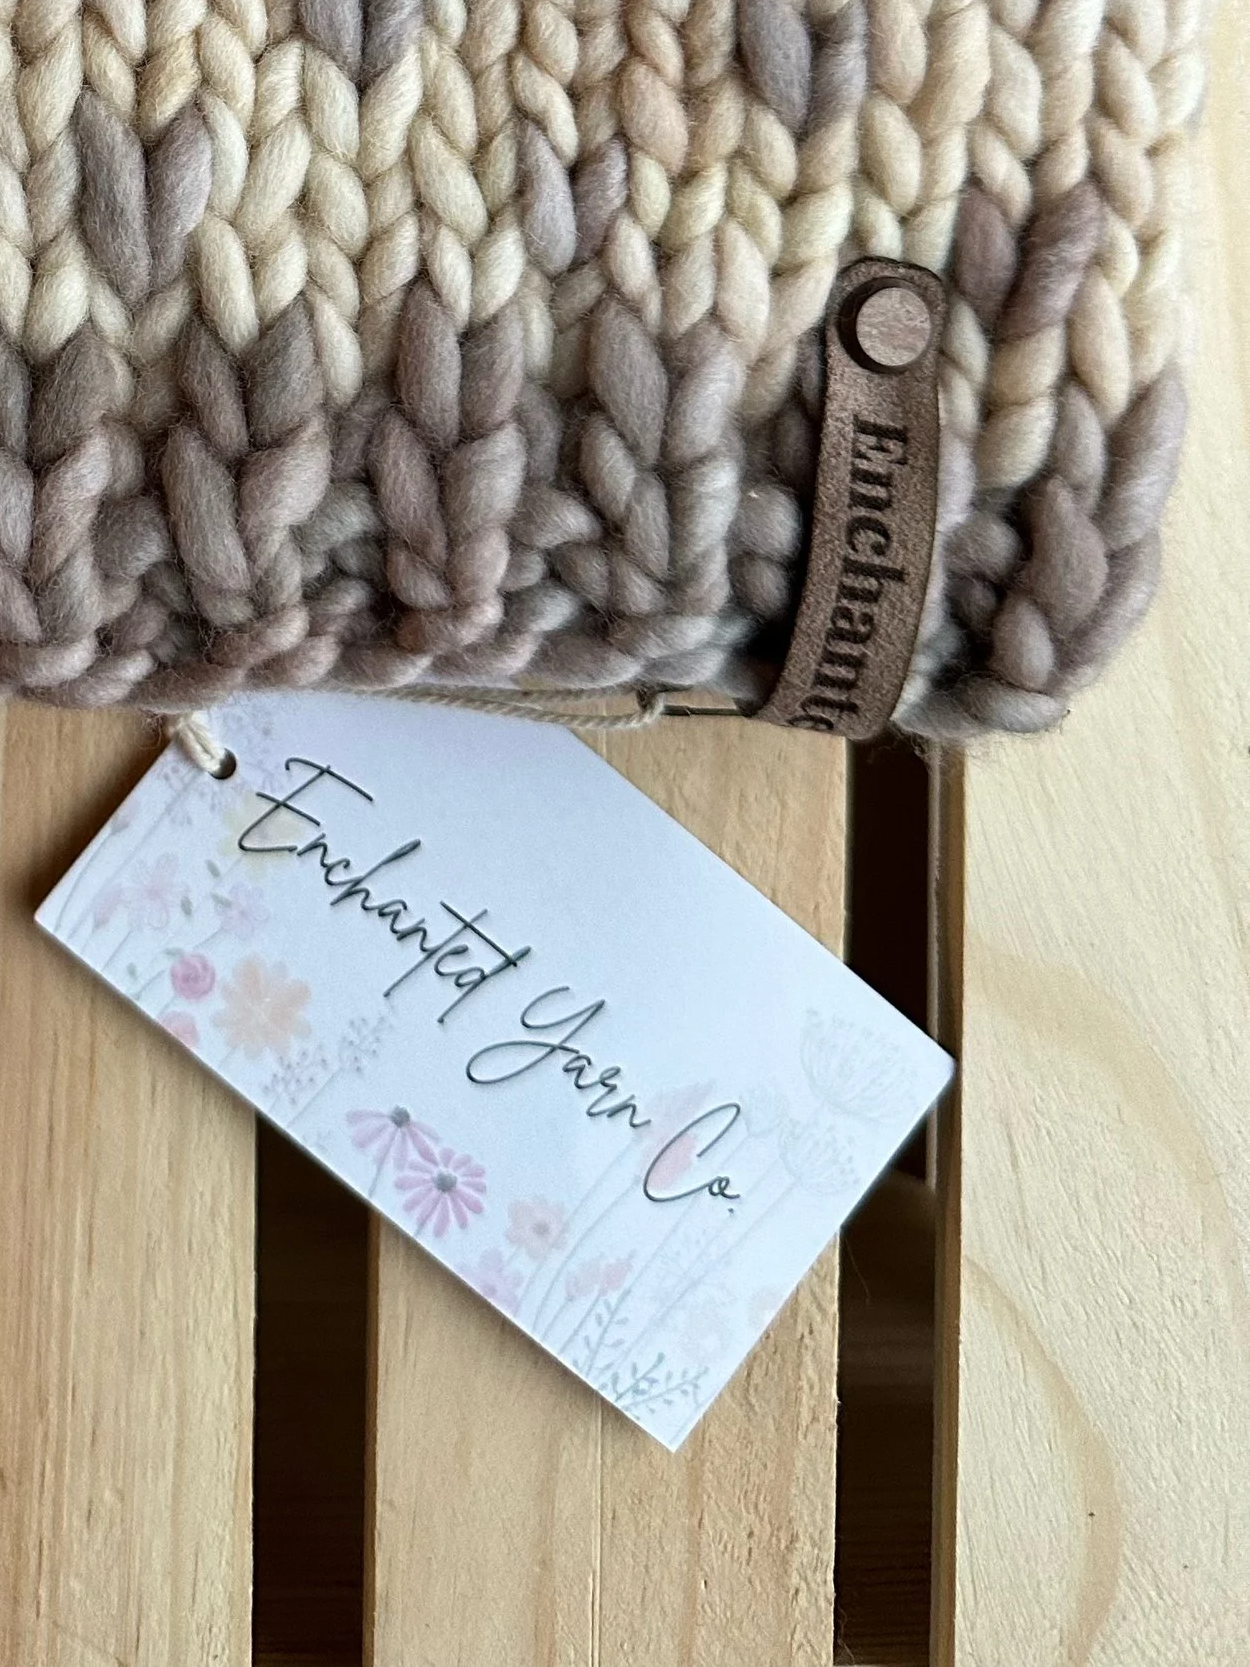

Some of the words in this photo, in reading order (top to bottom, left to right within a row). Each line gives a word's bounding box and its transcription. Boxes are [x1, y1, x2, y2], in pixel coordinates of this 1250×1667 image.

[238, 757, 532, 1024] Enchanted
[465, 985, 652, 1129] Yarn
[643, 1102, 743, 1215] Co.
